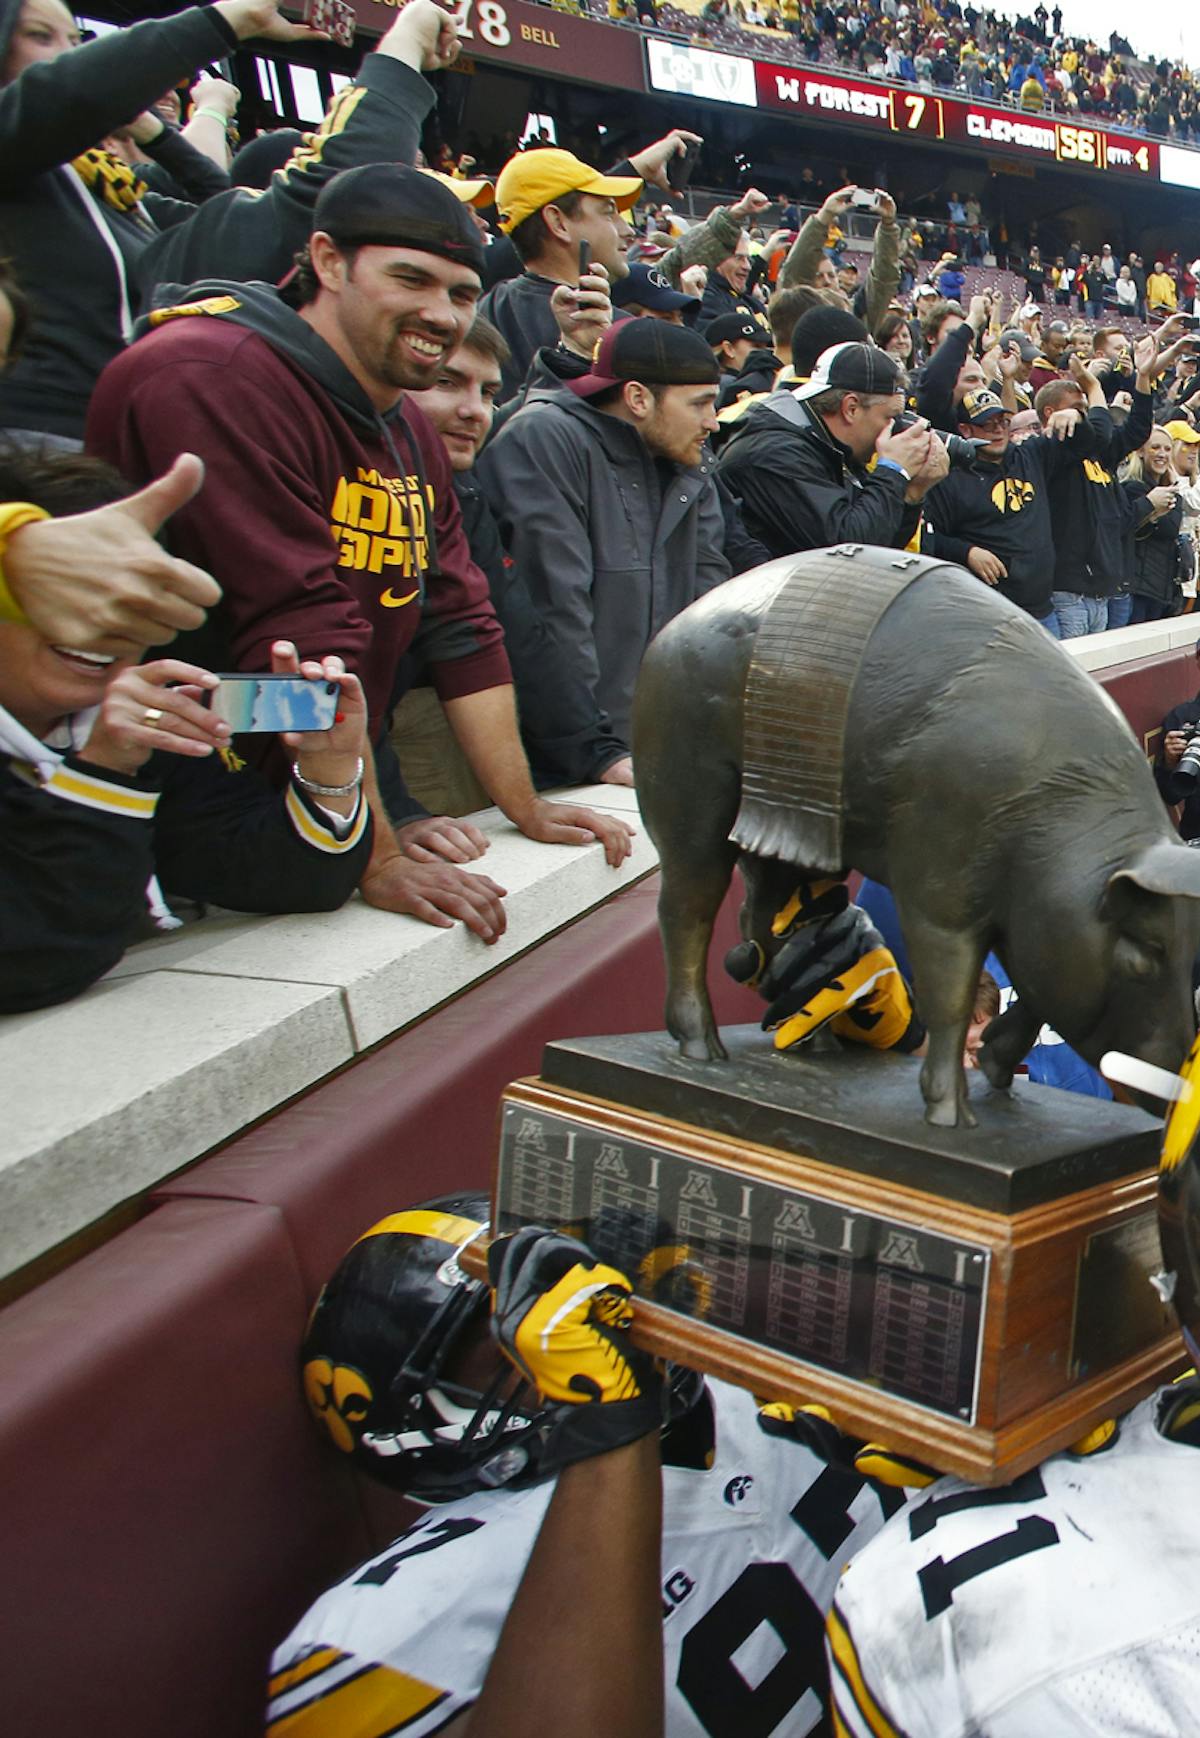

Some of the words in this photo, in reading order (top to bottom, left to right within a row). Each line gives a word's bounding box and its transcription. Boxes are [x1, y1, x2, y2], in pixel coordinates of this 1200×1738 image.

[520, 24, 560, 49] BELL
[775, 76, 800, 102] W
[805, 81, 889, 118] FOREST
[904, 96, 925, 129] 7
[967, 113, 1055, 151] CLEMSON
[1060, 125, 1095, 162] 56
[1135, 147, 1149, 171] 4
[565, 1131, 578, 1162] I
[648, 1157, 662, 1189] I
[680, 1170, 718, 1208] M
[740, 1185, 754, 1220] I
[774, 1199, 816, 1239] M
[840, 1215, 856, 1252] I
[878, 1231, 925, 1273] M
[953, 1250, 969, 1287] I
